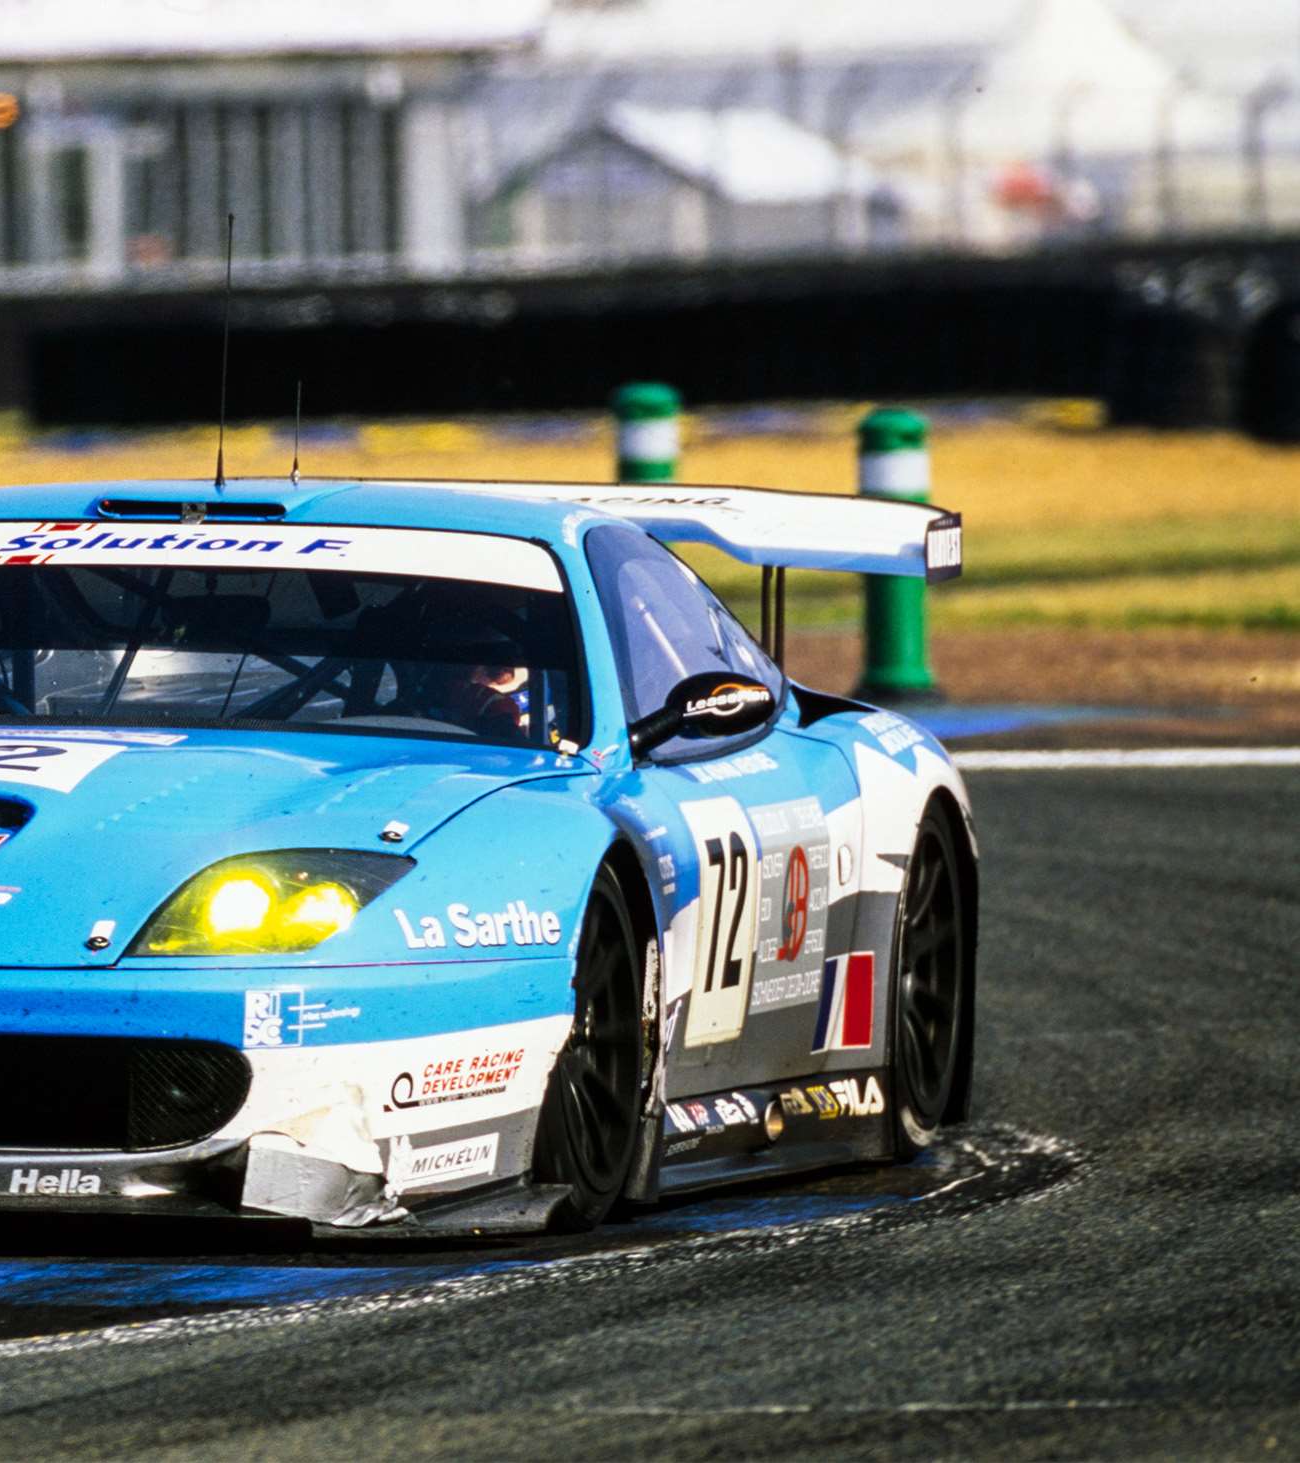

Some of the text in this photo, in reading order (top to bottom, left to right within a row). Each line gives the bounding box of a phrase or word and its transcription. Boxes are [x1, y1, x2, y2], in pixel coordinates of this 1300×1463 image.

[393, 900, 561, 949] La Sarthe
[704, 831, 748, 993] 72
[423, 1048, 525, 1078] CARE RACING
[422, 1065, 520, 1095] DEVELOPMENT
[828, 1076, 884, 1117] FILA
[411, 1143, 493, 1174] MICHELIN
[9, 1168, 101, 1195] Hella
